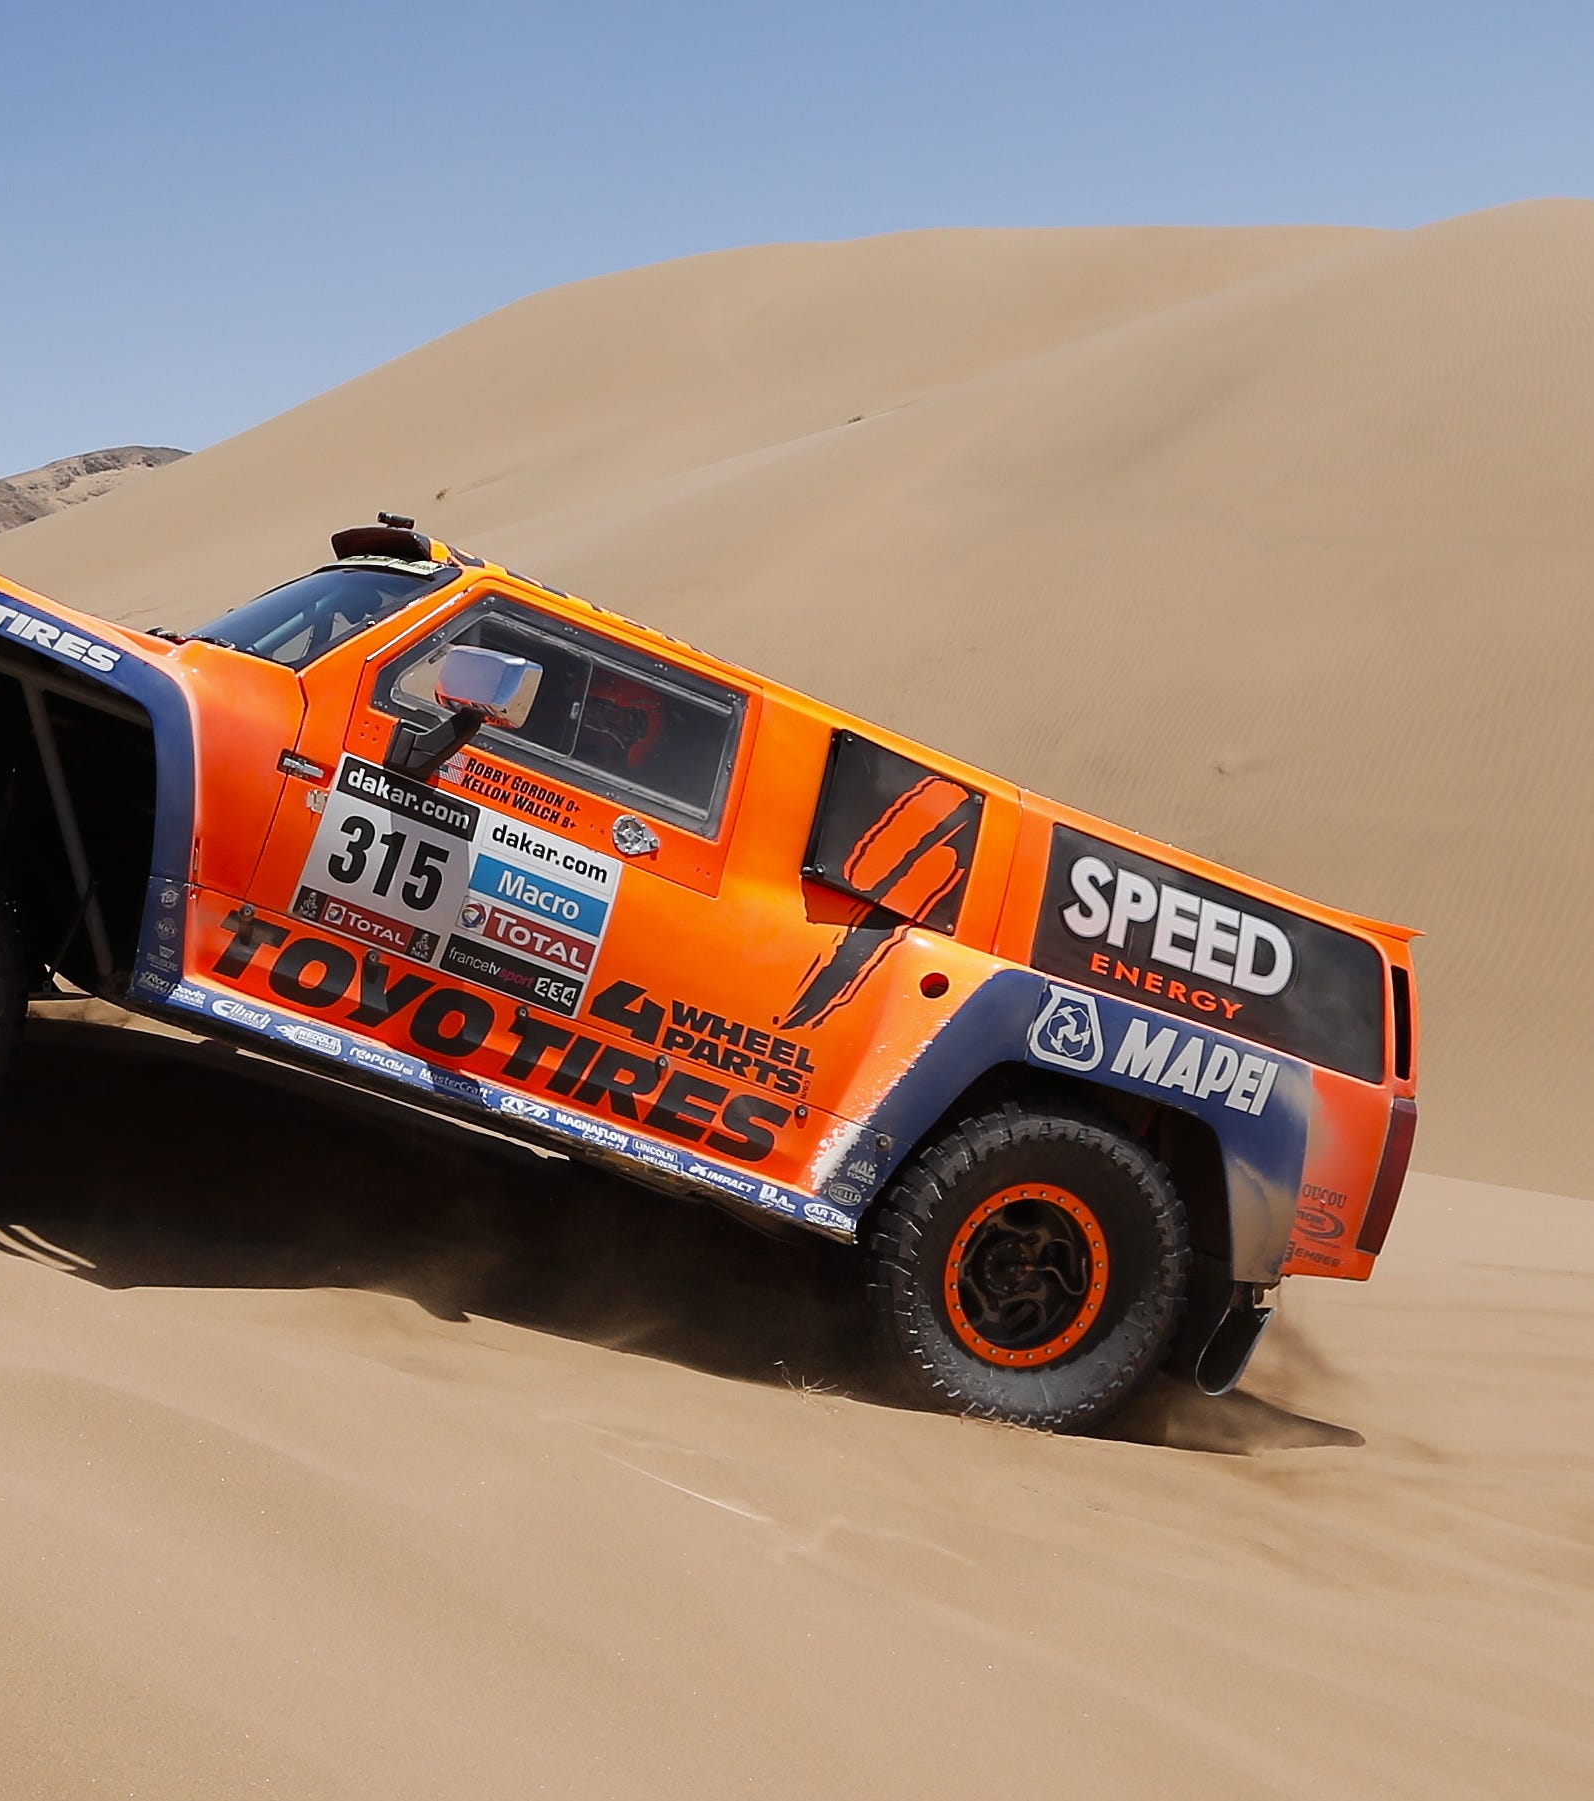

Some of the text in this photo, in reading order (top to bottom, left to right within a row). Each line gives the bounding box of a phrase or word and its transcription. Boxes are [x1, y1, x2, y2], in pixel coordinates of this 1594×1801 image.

[347, 767, 471, 832] dakar.com
[460, 773, 512, 805] KELLON
[511, 793, 563, 824] WALCH
[466, 757, 512, 786] ROBBY
[510, 775, 566, 808] GORDON
[328, 814, 450, 911] 315
[491, 823, 608, 884] dakar.com
[497, 869, 581, 921] Macro
[1062, 855, 1293, 997] SPEED
[347, 911, 406, 946] TOTAL
[493, 912, 587, 970] TOTAL
[1090, 952, 1245, 1020] ENERGY
[211, 908, 793, 1162] TOYO TIRES
[589, 979, 815, 1074] 4 WHEEL
[662, 1028, 803, 1095] PARTS
[1111, 1018, 1280, 1116] MAPEI
[634, 1141, 675, 1161] LINCOLN
[707, 1170, 756, 1193] IMPACT
